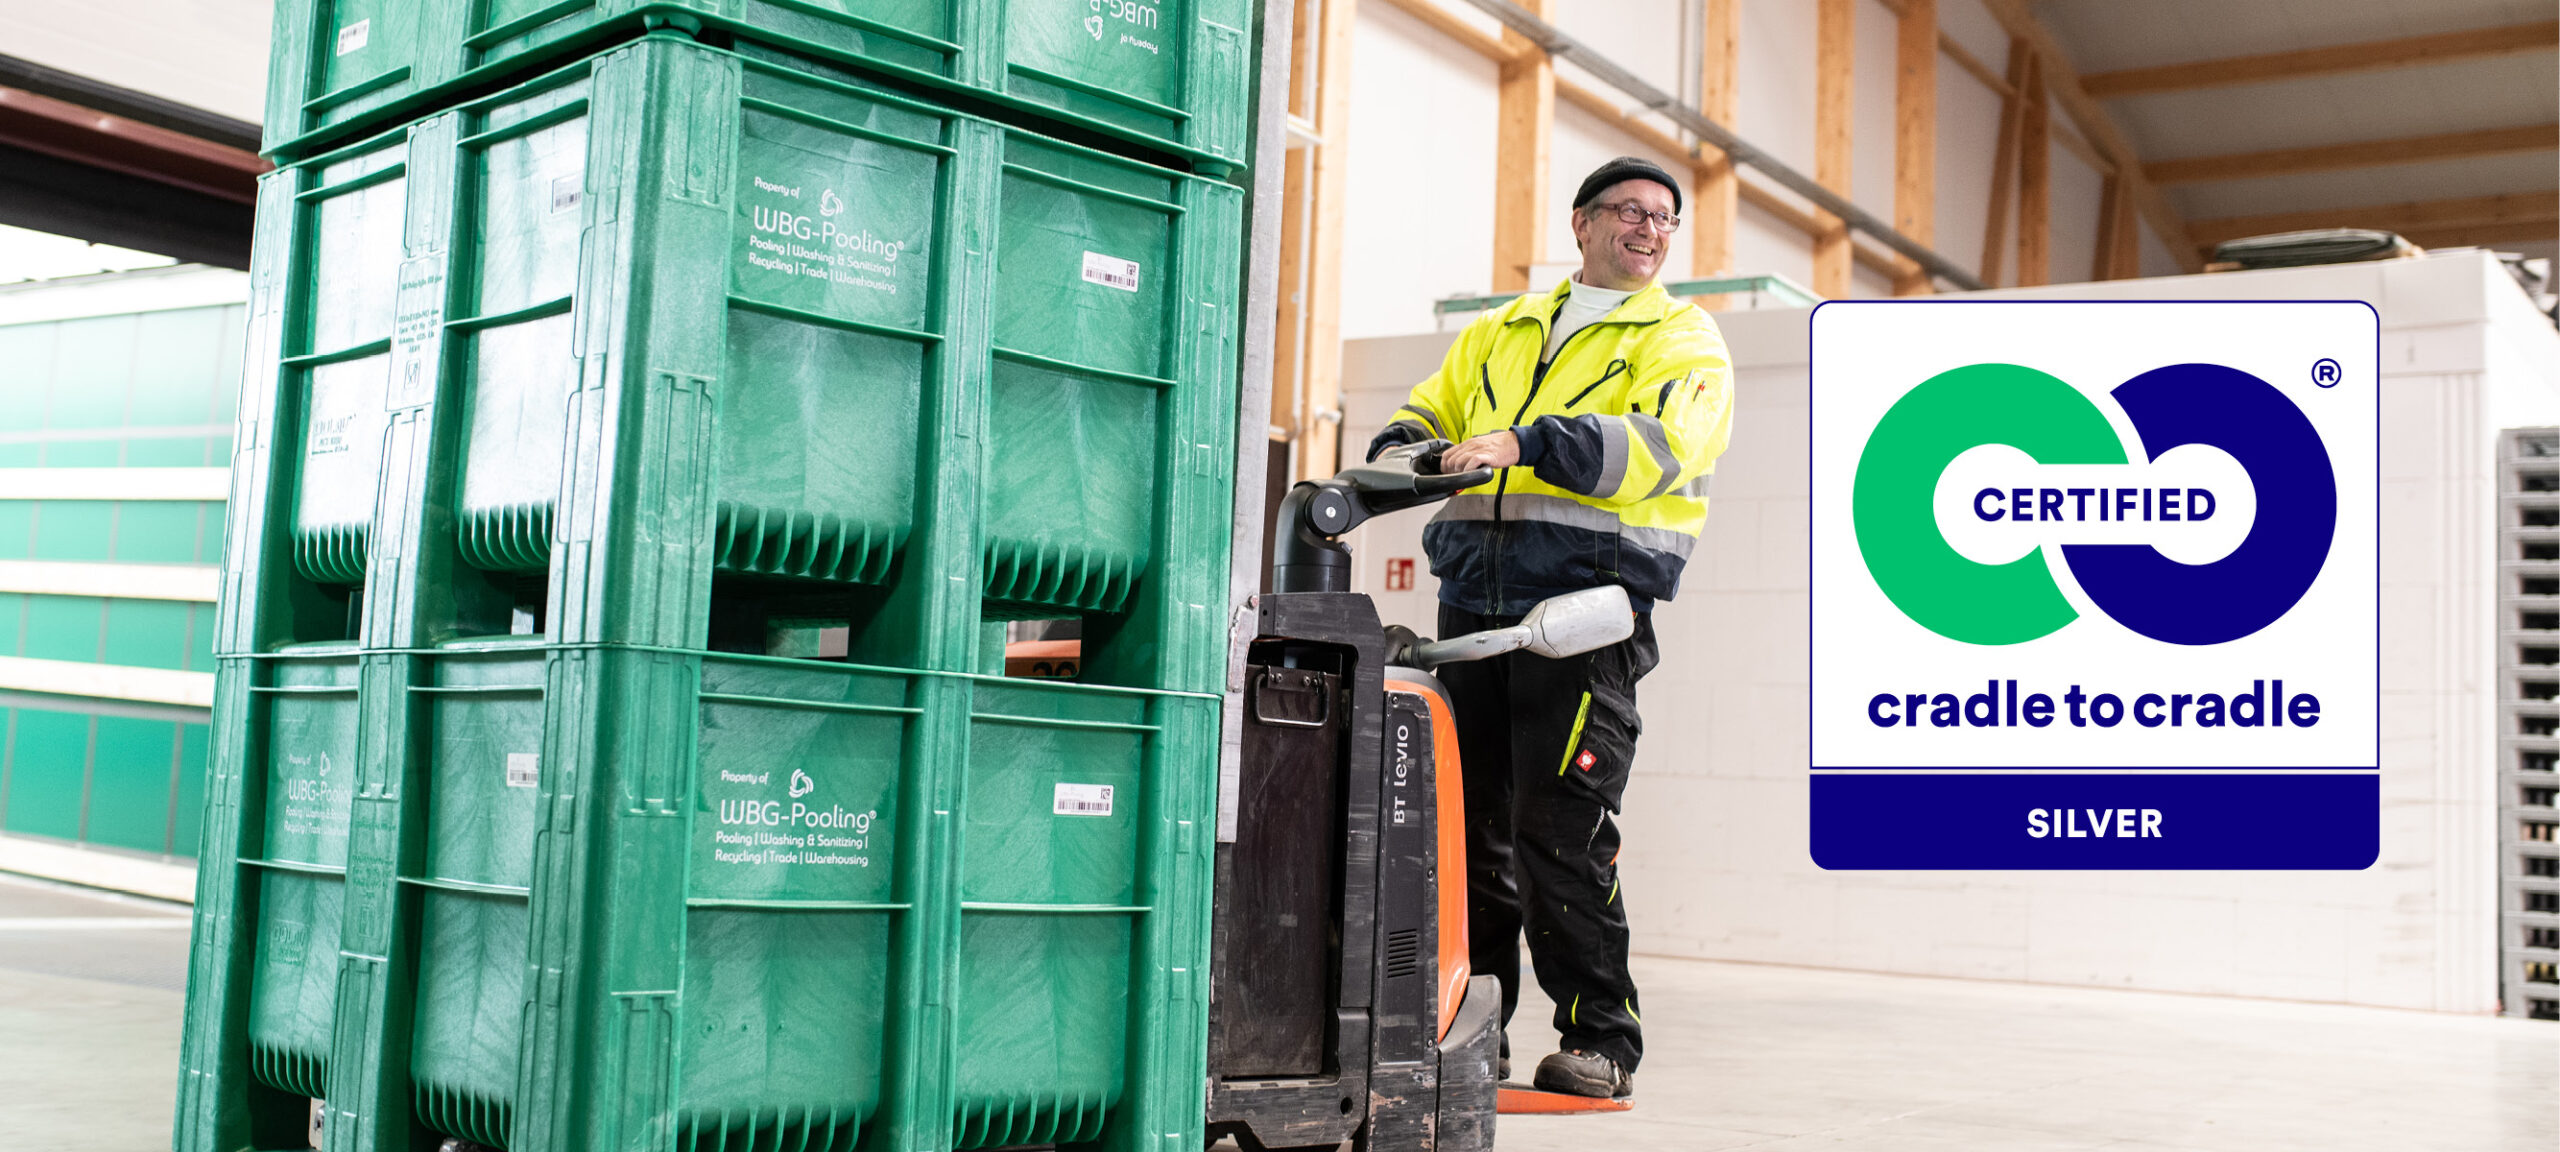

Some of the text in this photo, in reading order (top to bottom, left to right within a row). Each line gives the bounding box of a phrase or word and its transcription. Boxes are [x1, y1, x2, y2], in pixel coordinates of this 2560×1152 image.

[754, 176, 800, 199] Property of
[750, 235, 785, 256] Pooling
[792, 244, 834, 265] Washing
[847, 256, 891, 277] Sanitizing
[749, 252, 793, 274] Recycling
[801, 263, 828, 279] Trade
[835, 271, 896, 294] Warehousing
[721, 769, 770, 785] Property of
[1393, 796, 1406, 824] BT
[715, 831, 752, 846] Pooling
[760, 832, 804, 848] Washing
[817, 834, 863, 850] Sanitizing
[715, 849, 761, 864] Recycling
[769, 850, 798, 864] Trade
[805, 852, 868, 867] Warehousing
